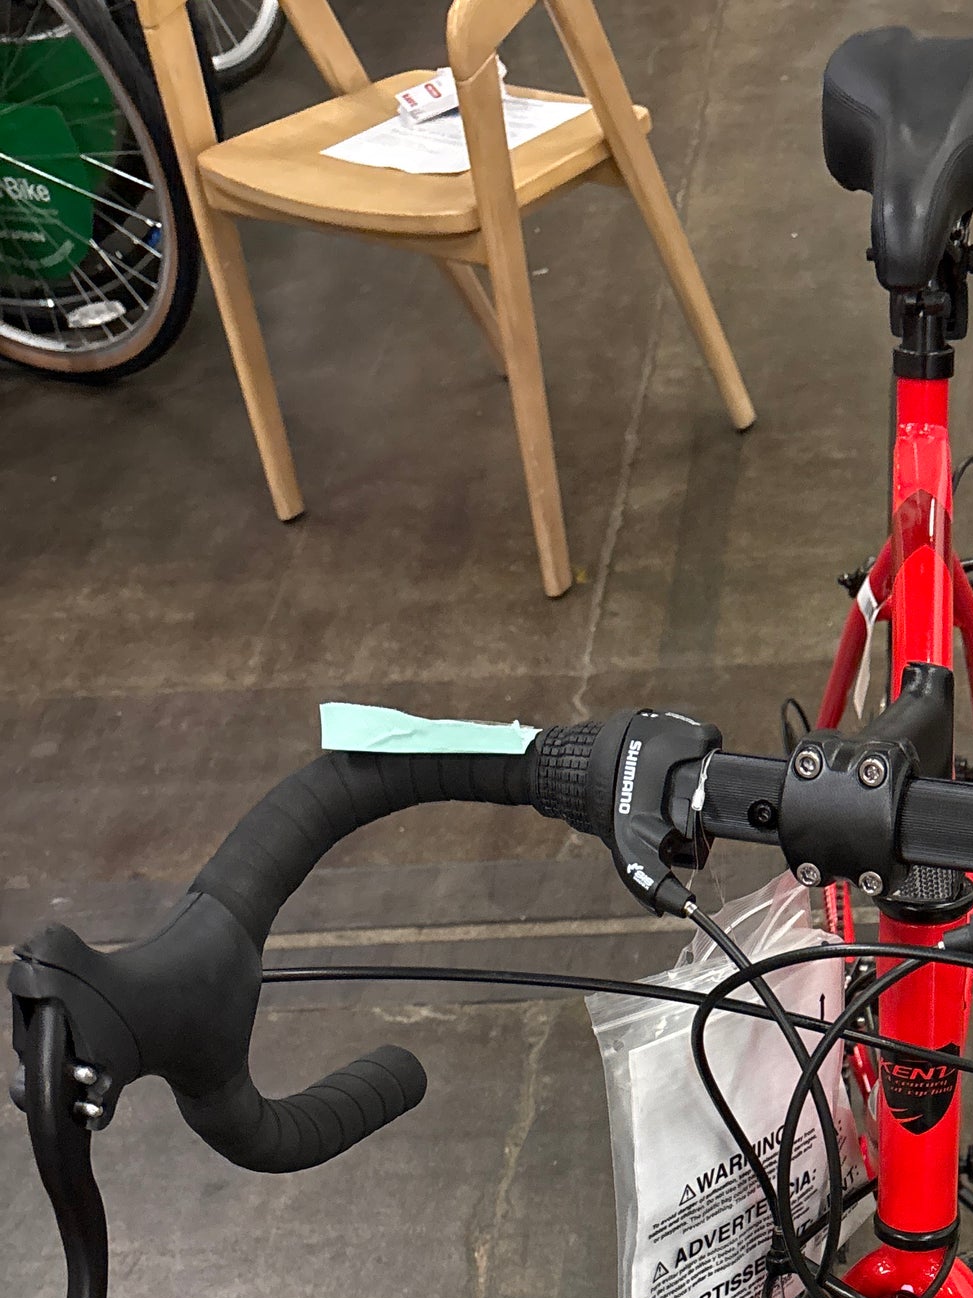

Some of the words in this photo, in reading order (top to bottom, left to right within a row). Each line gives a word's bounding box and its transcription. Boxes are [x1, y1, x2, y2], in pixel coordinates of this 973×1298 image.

[619, 739, 642, 815] SHIMANO
[880, 1056, 948, 1080] KENT
[674, 1167, 817, 1268] ADVERTEIA:
